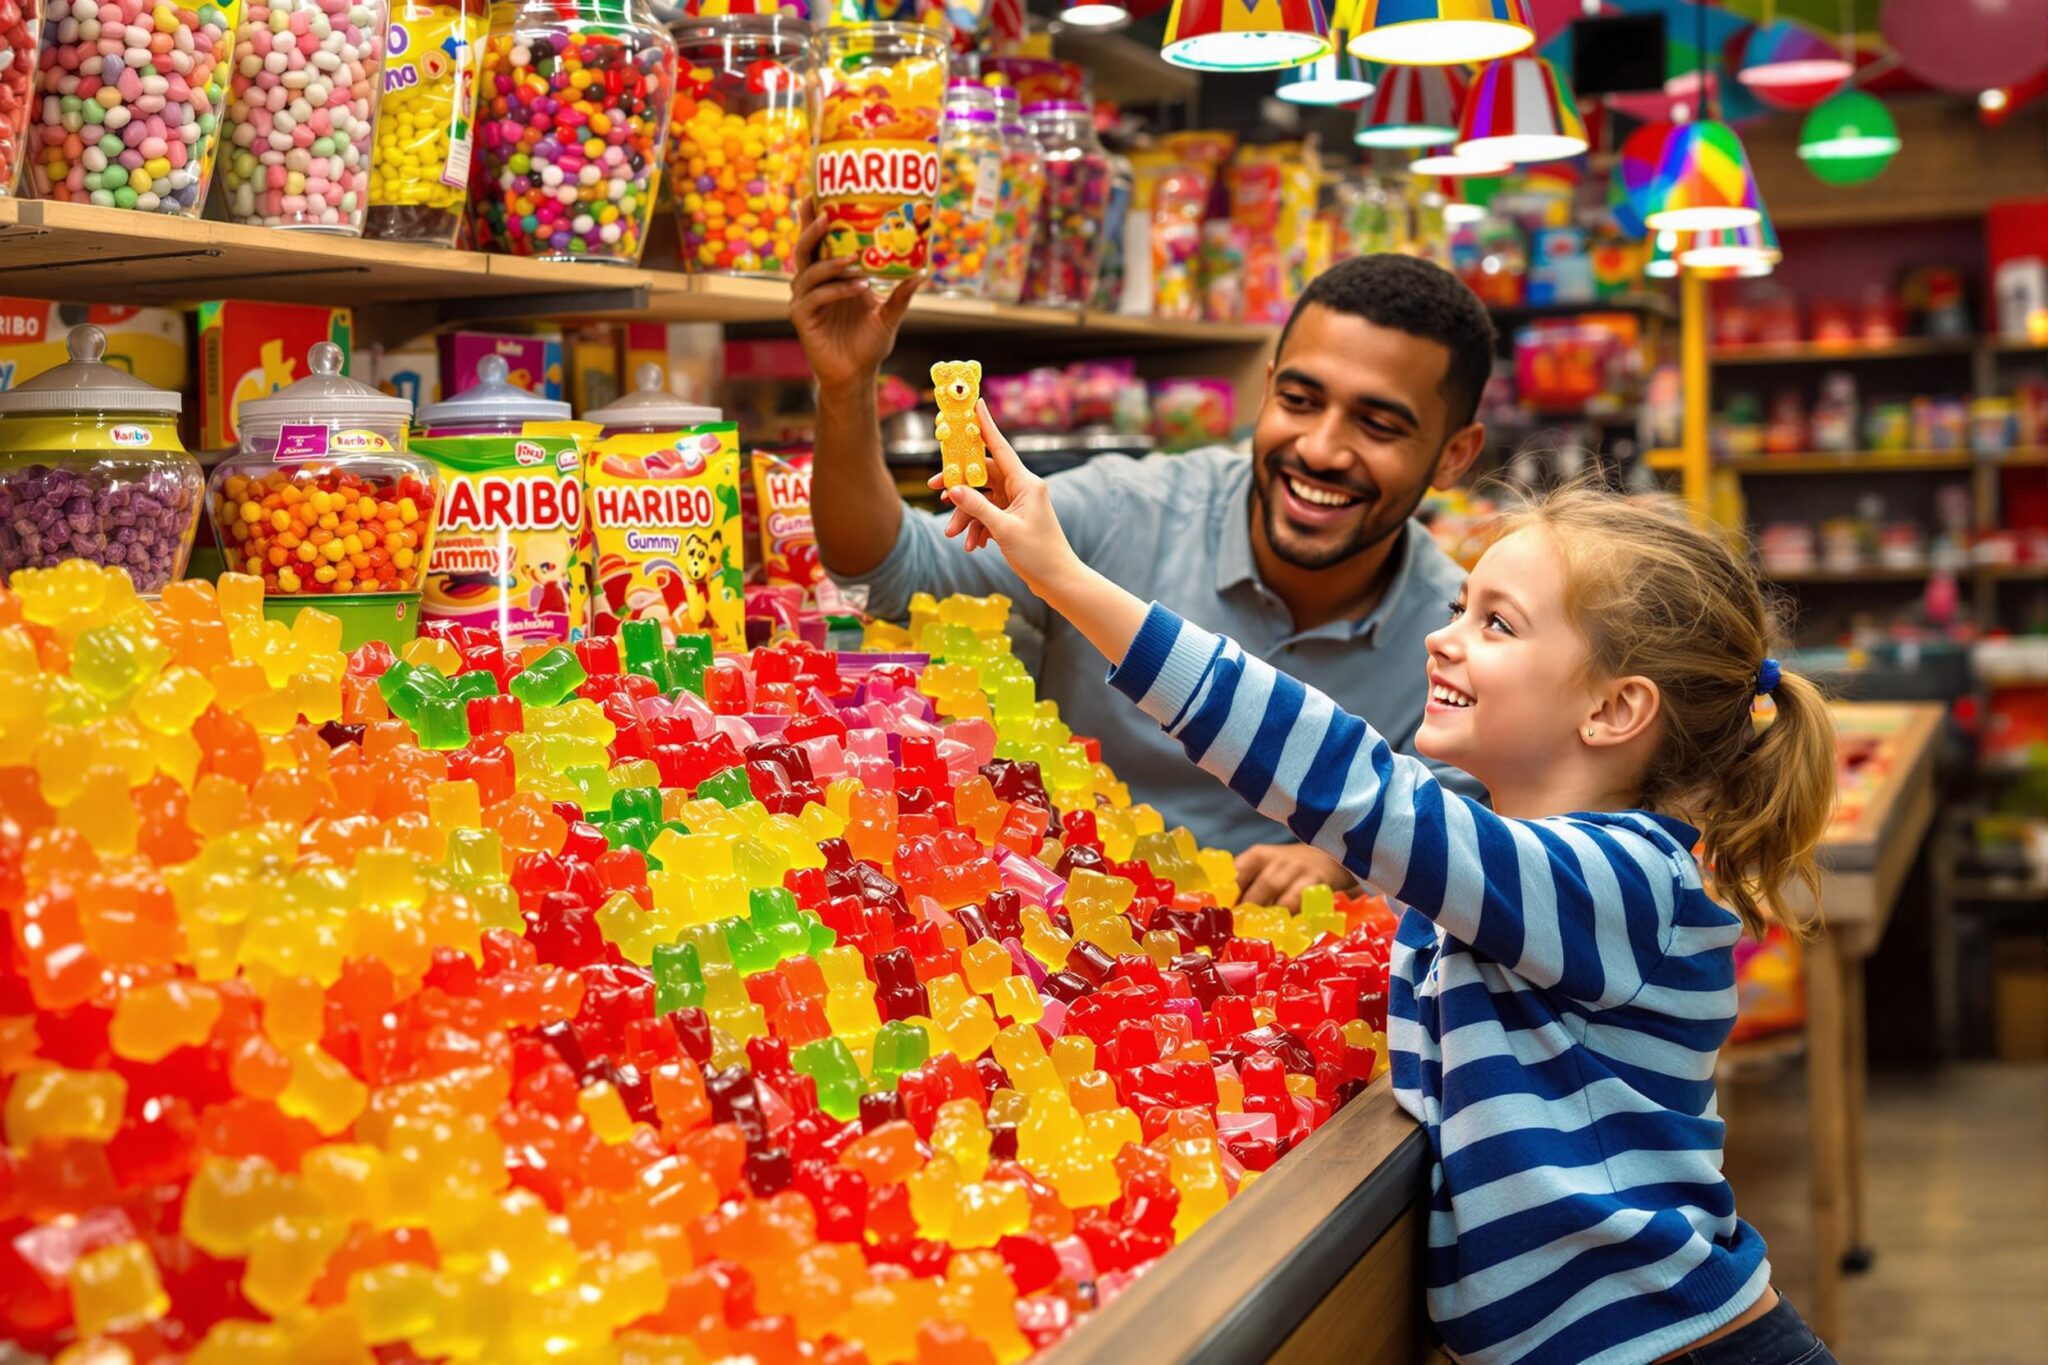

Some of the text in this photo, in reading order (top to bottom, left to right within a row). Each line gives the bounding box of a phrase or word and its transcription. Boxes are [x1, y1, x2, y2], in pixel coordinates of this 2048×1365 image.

[819, 152, 938, 193] HARIBO
[597, 488, 711, 524] HARIBO
[769, 476, 815, 506] HA
[627, 531, 679, 554] Gummy
